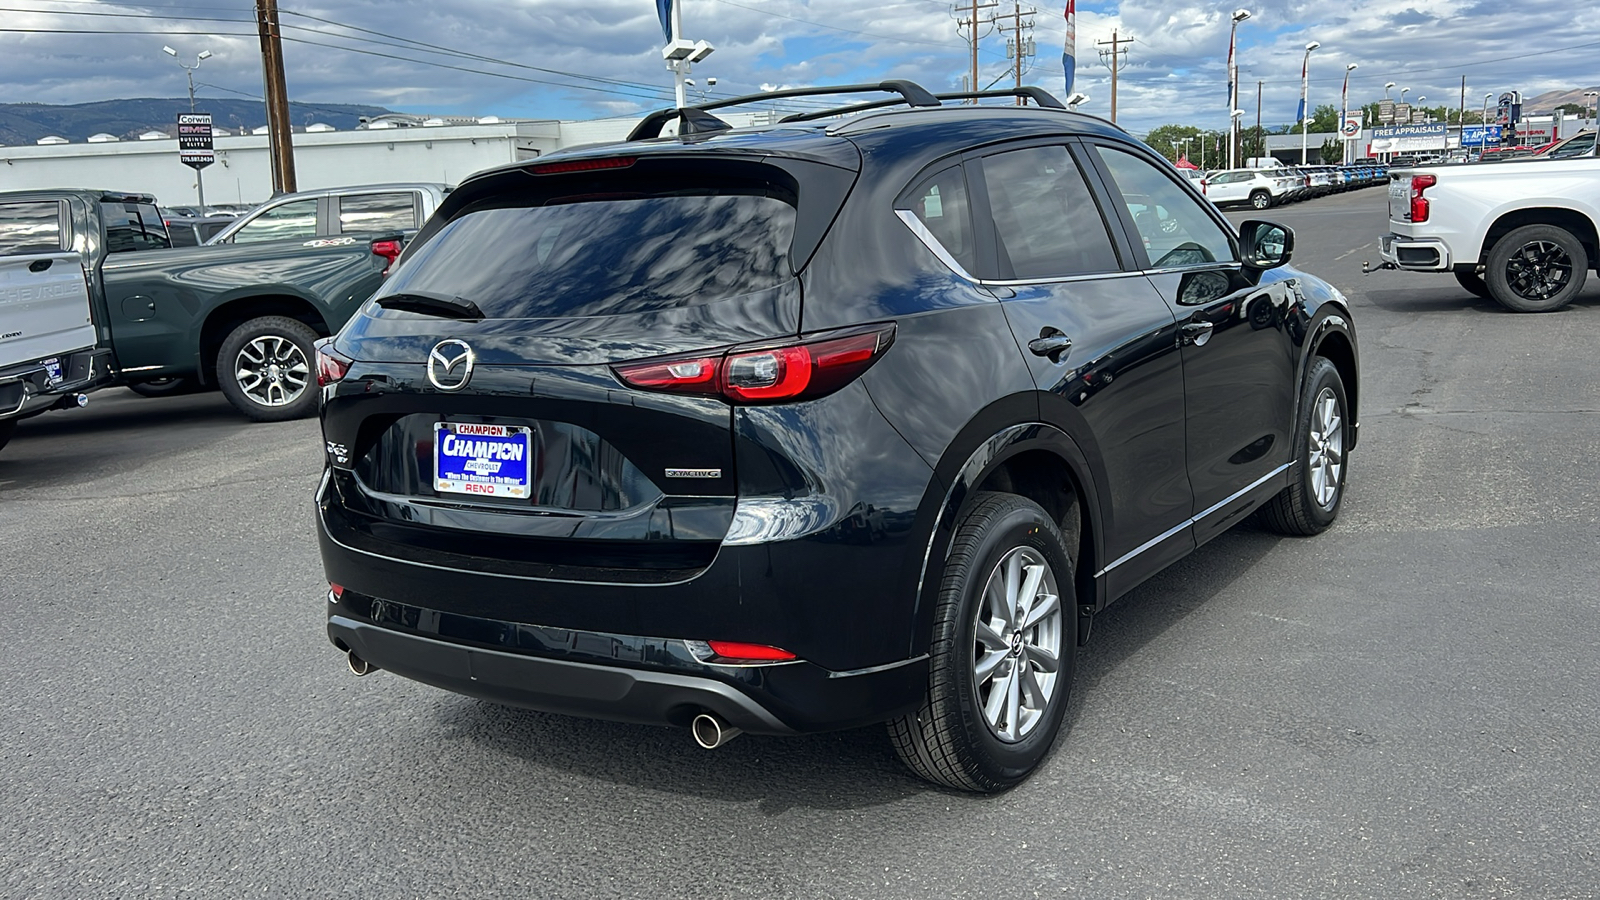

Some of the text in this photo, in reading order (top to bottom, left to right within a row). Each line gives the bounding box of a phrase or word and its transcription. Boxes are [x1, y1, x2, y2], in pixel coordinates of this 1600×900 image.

[1374, 125, 1444, 137] FREE APPRAISALS!
[459, 425, 503, 436] CHAMPION
[443, 434, 524, 461] CHAMPION
[466, 462, 499, 471] CHEVROLET
[469, 473, 490, 482] Customer
[465, 483, 495, 494] RENO
